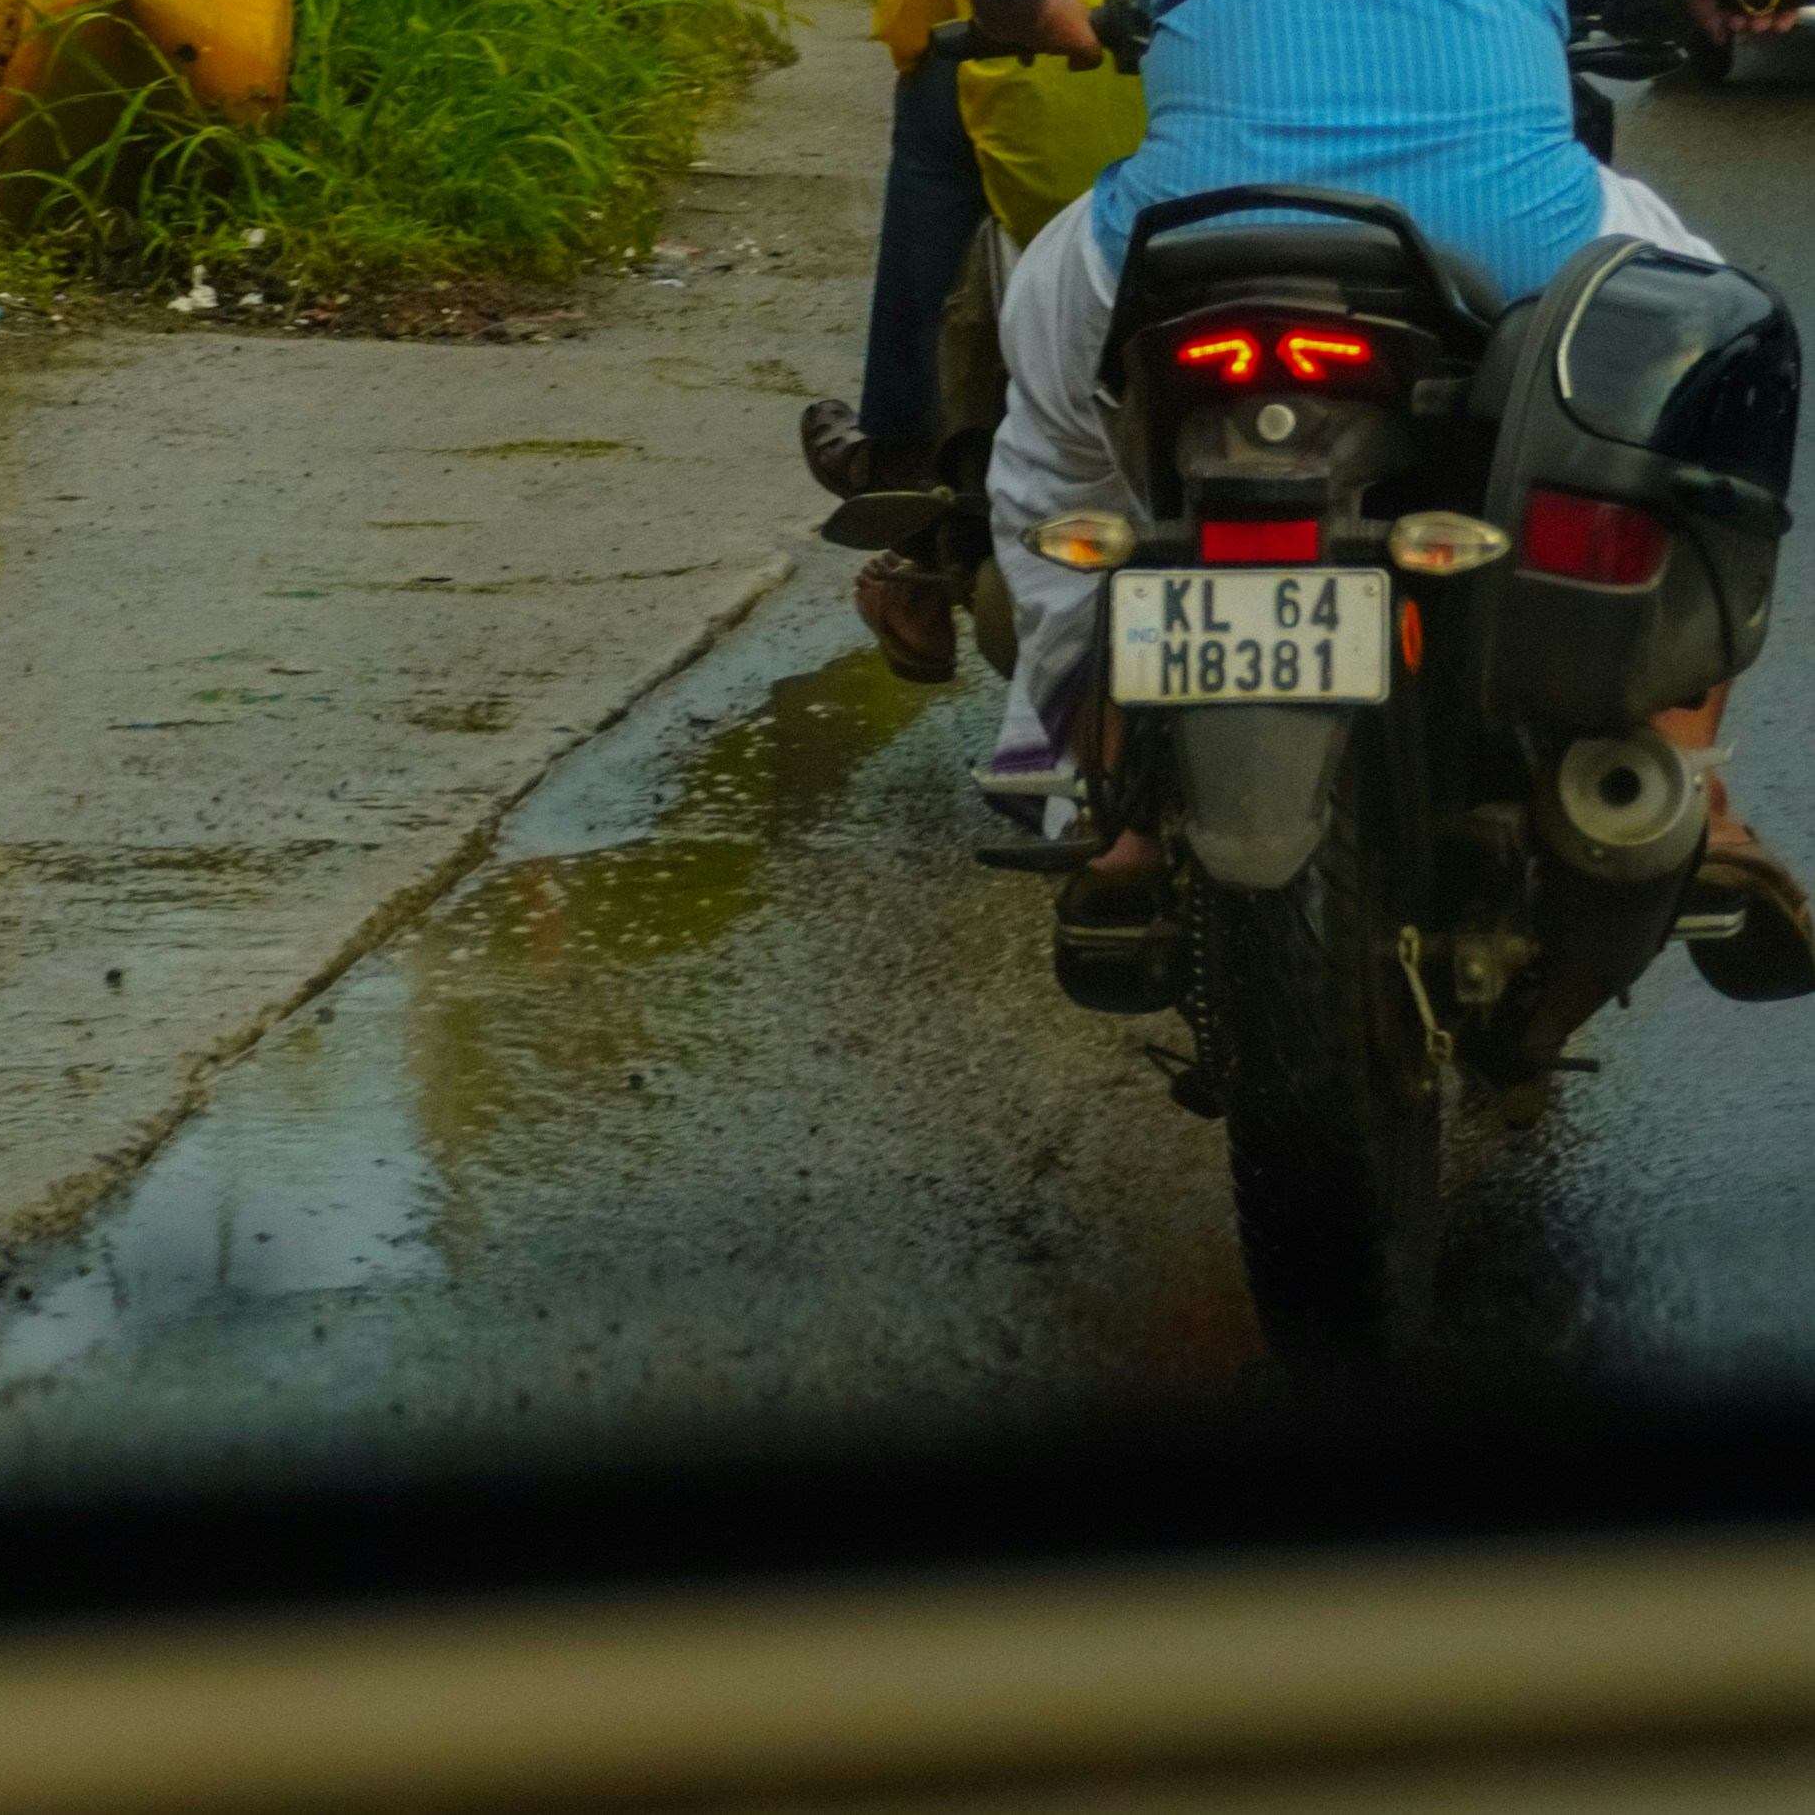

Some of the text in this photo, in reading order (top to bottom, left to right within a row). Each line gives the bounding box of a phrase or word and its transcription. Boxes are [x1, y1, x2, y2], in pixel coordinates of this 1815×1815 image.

[1163, 577, 1340, 633] KL 64
[1161, 637, 1334, 696] M8381
